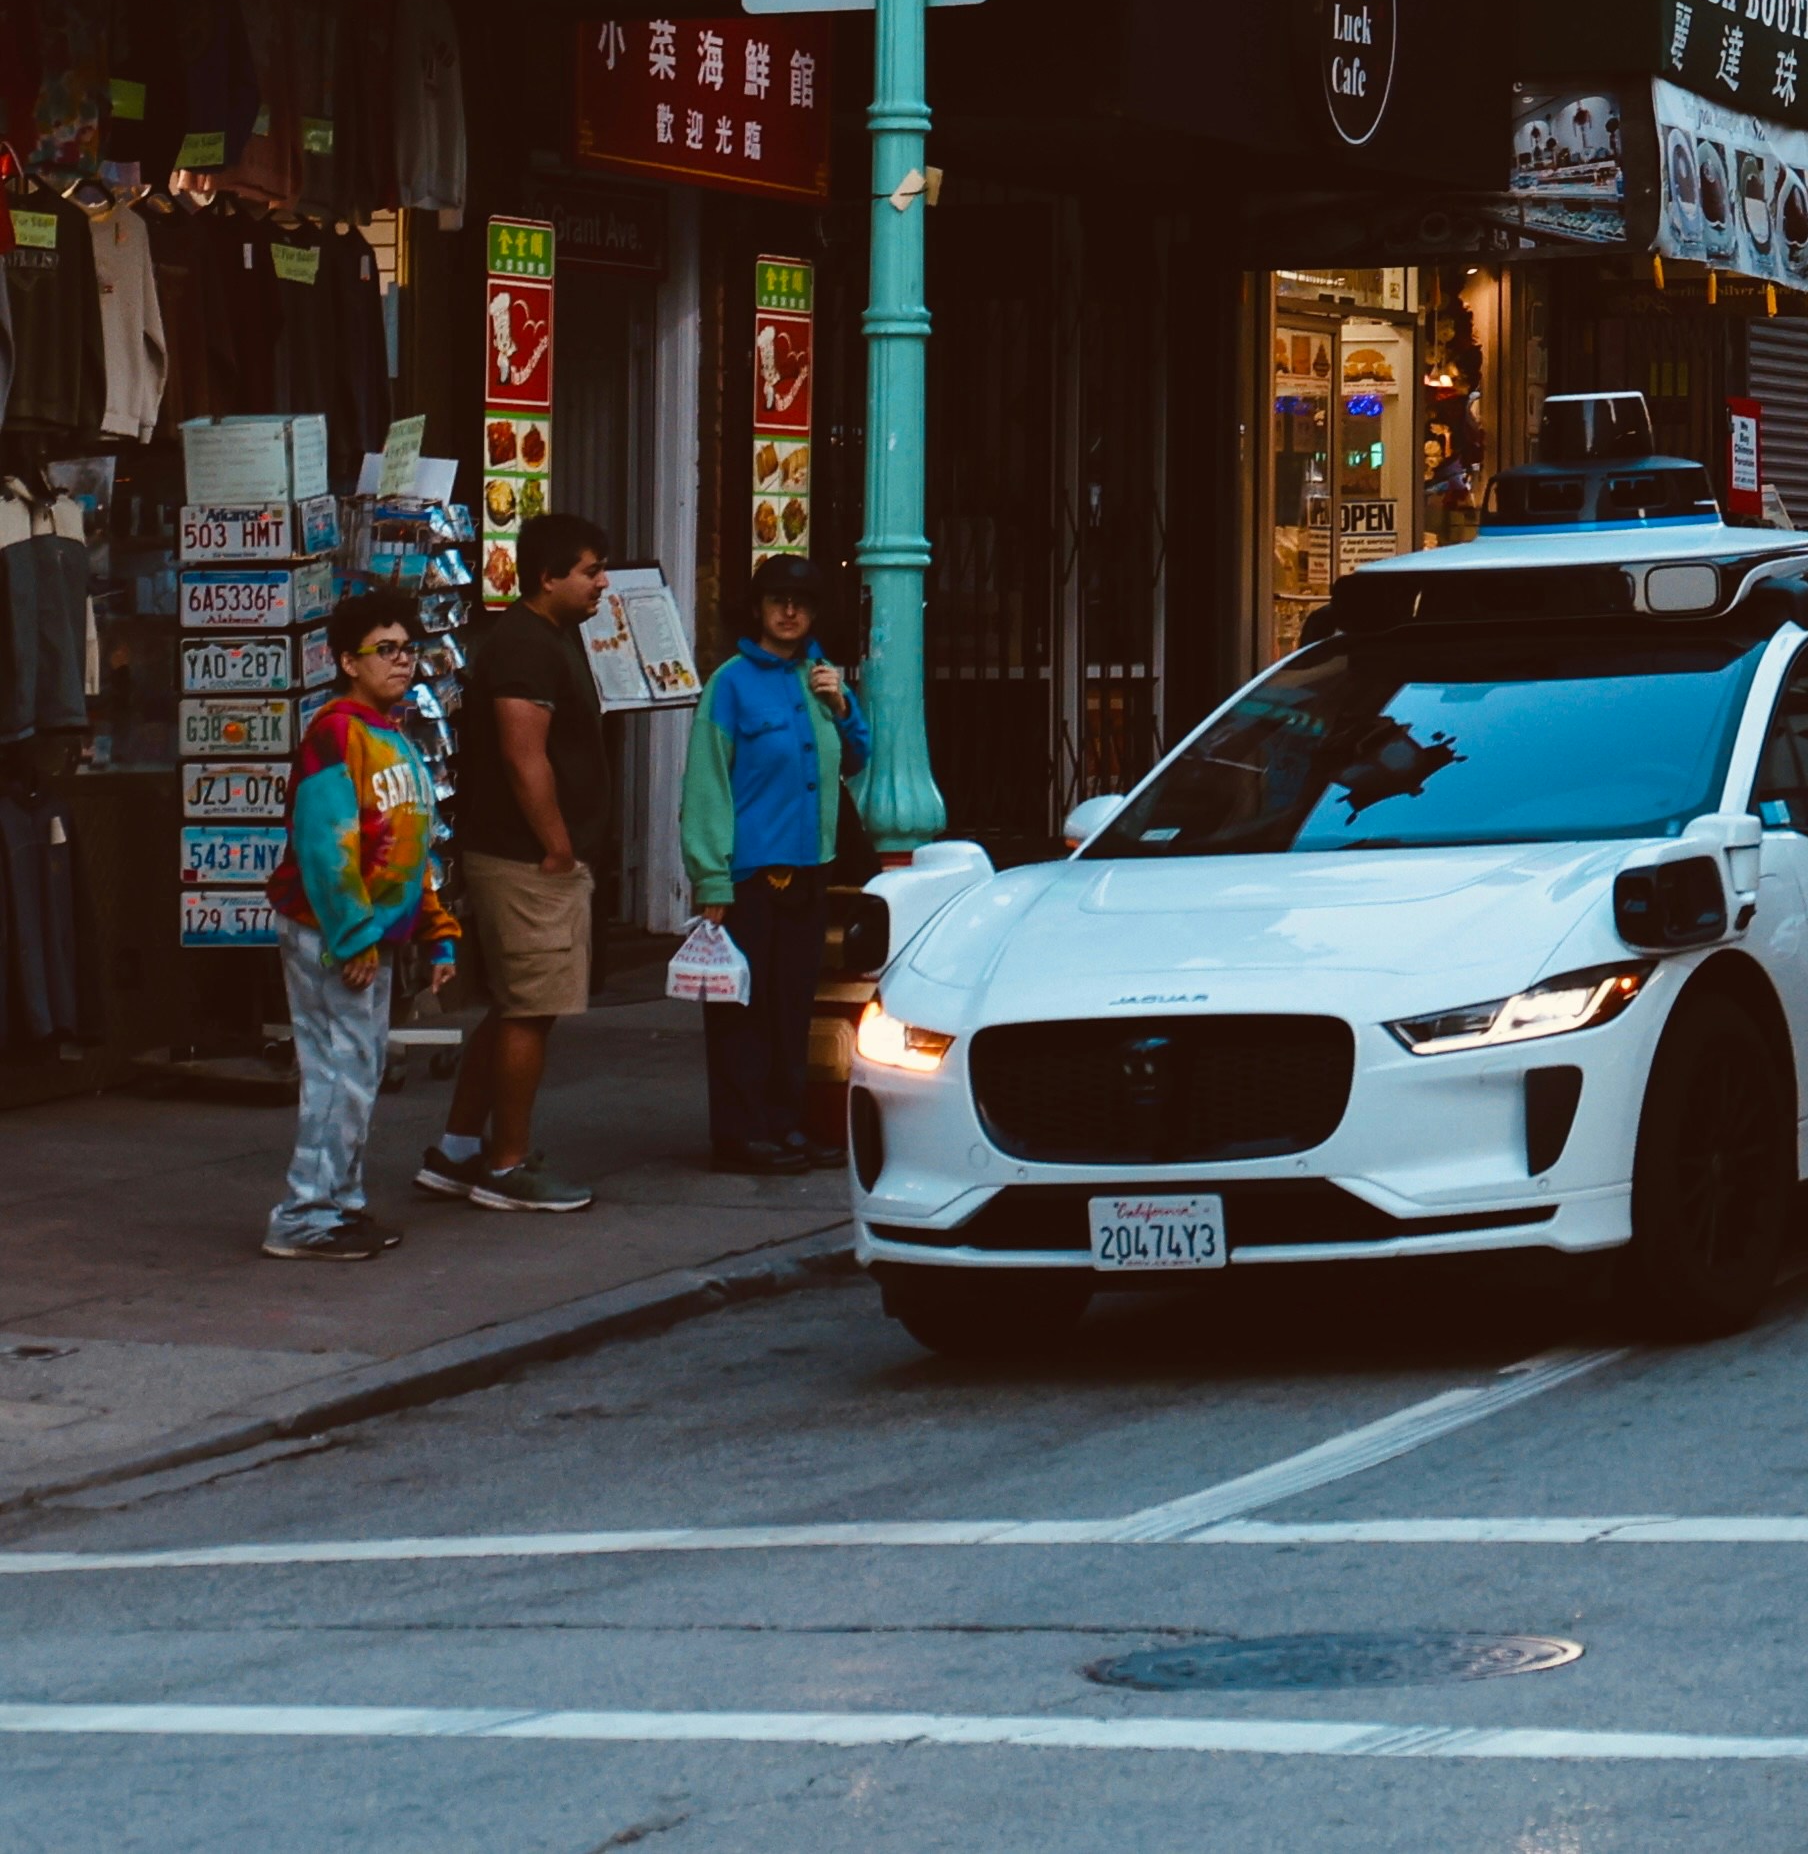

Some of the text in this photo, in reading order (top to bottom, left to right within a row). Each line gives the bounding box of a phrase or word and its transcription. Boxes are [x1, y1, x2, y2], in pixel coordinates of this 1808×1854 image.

[1333, 3, 1373, 47] Luck
[597, 19, 817, 110] 小菜海鮮館
[1331, 55, 1368, 100] Cafe
[205, 508, 272, 523] Arkansa
[1339, 503, 1395, 533] OPEN
[184, 520, 285, 550] 503 HMT
[188, 583, 281, 613] 6A5336F
[190, 842, 231, 871] 543
[185, 907, 274, 935] 129 577
[1099, 1223, 1217, 1260] 20474Y3
